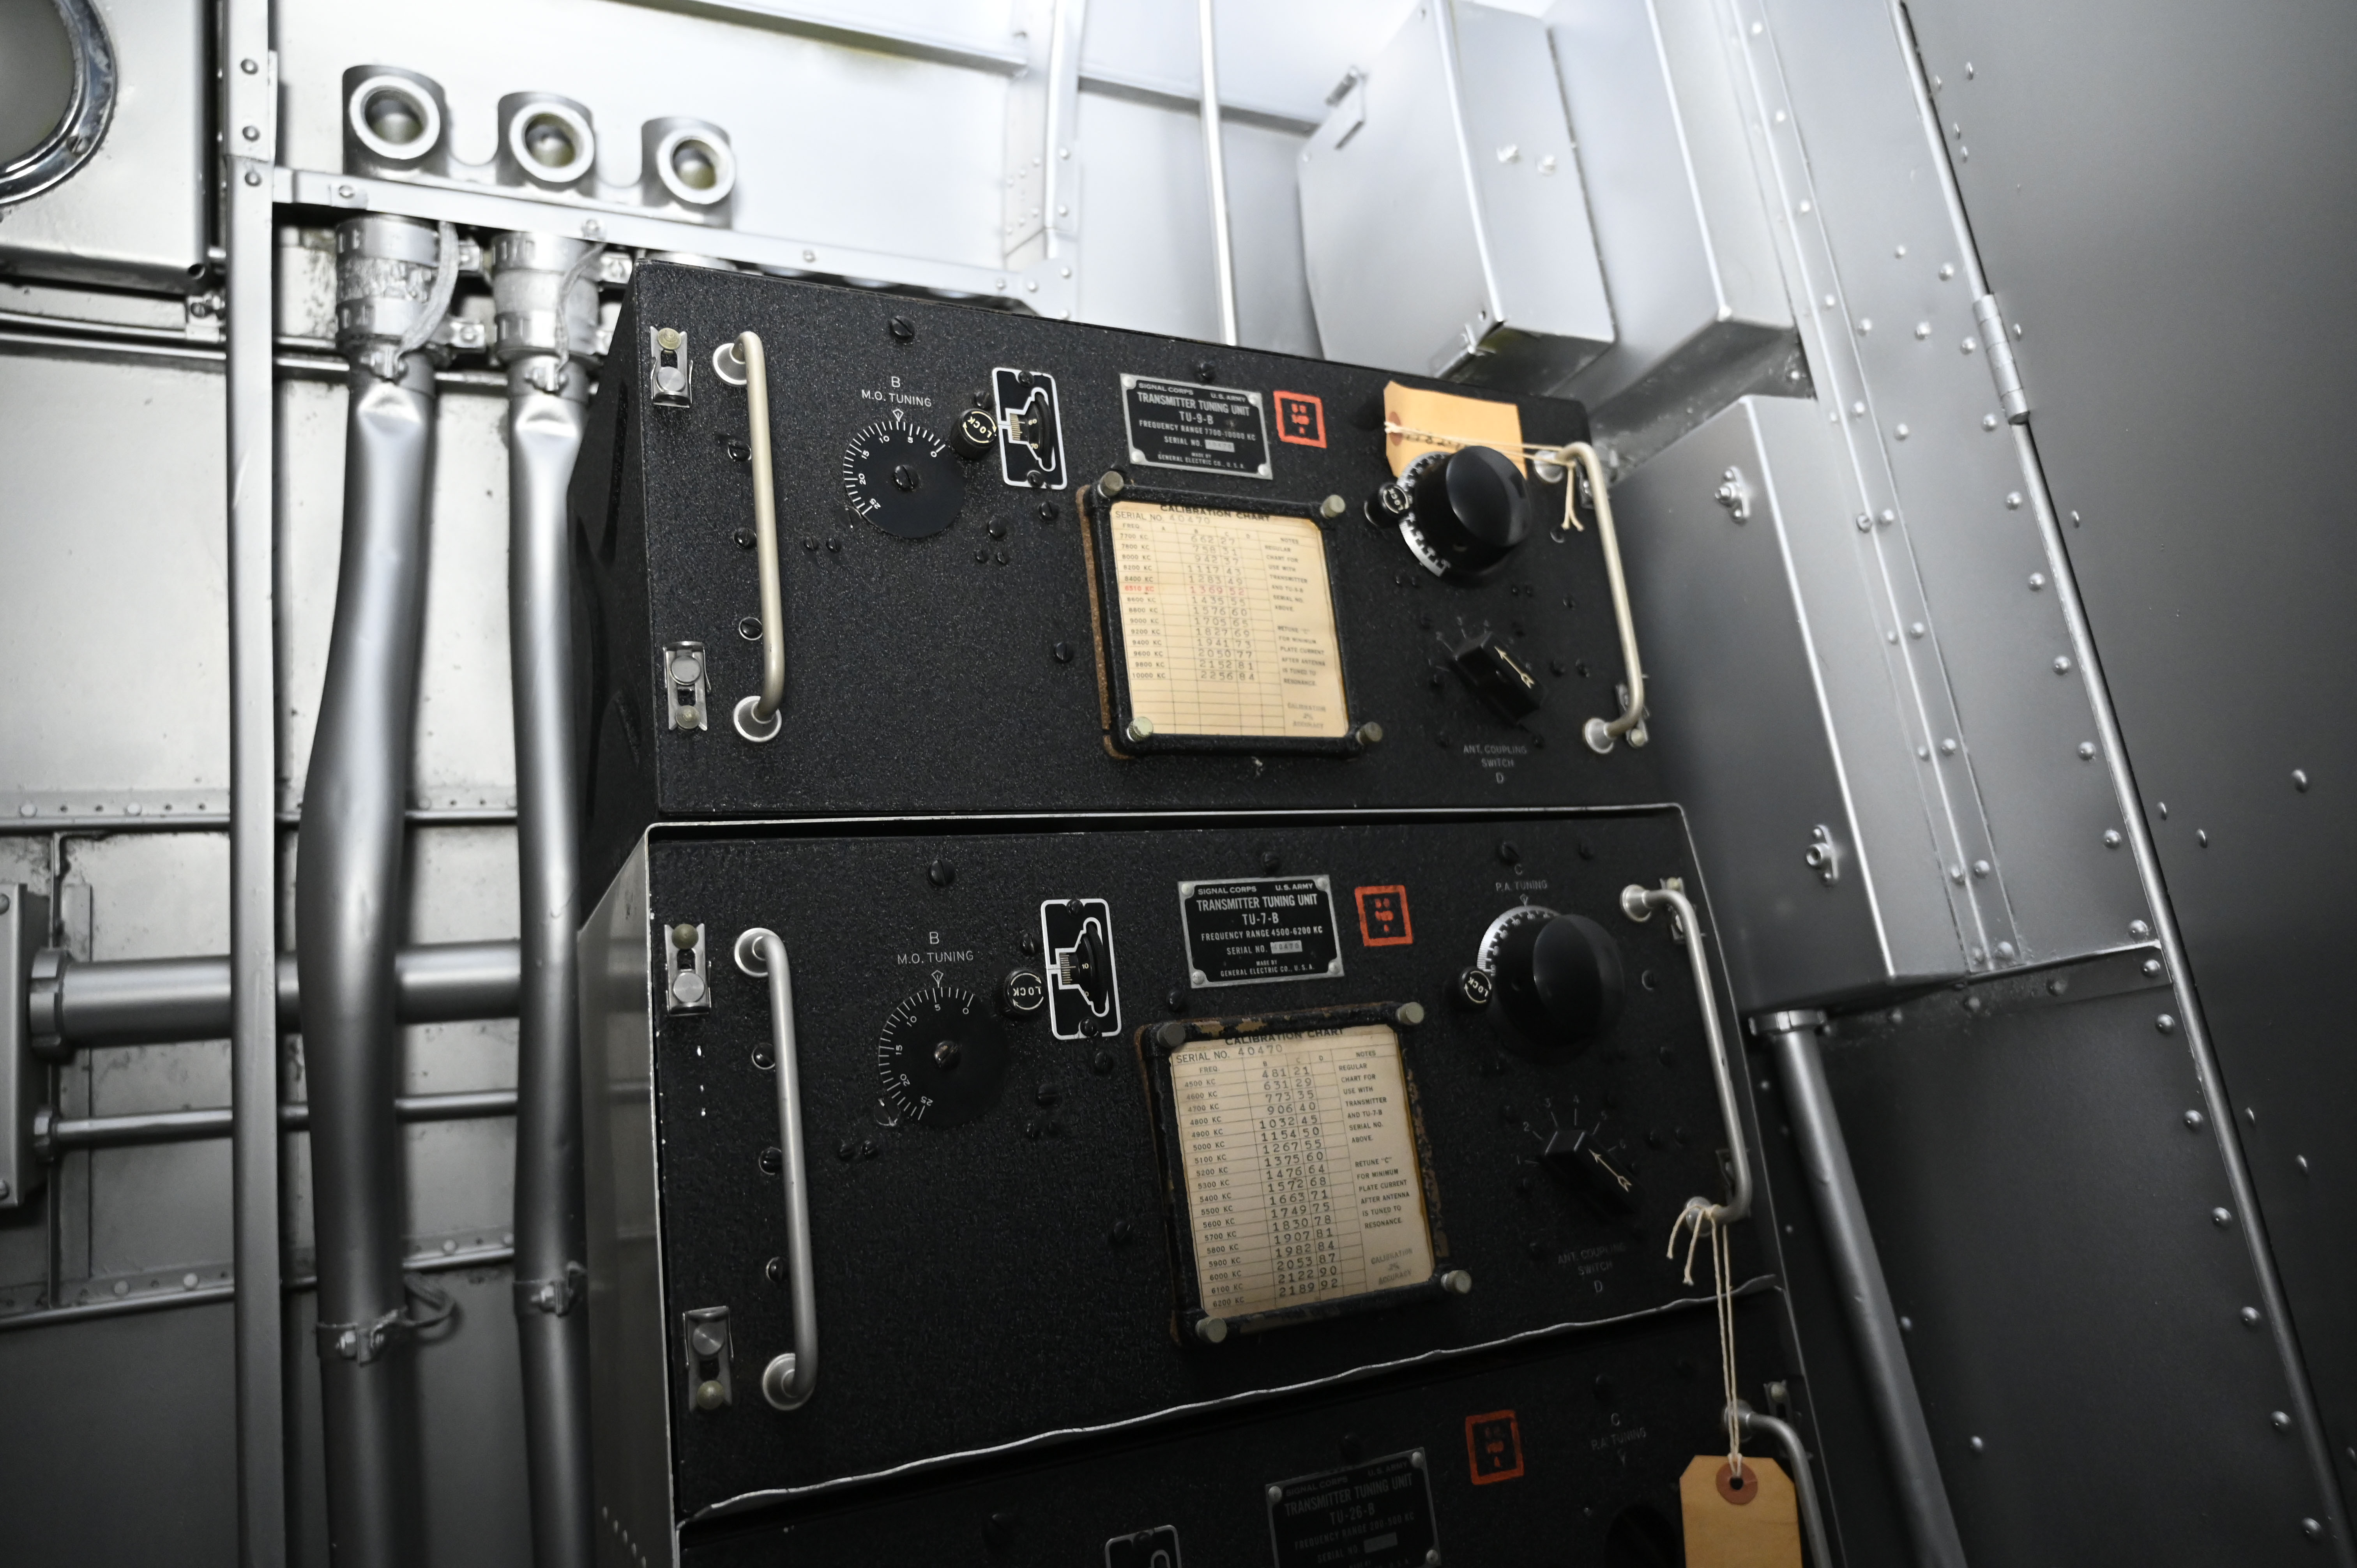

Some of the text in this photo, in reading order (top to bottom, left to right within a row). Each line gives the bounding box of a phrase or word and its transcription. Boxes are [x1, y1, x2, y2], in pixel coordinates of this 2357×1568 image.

[891, 376, 900, 387] B
[1138, 382, 1194, 396] SIGNAL CORPS
[862, 391, 932, 407] M.O. TUNING
[1137, 392, 1250, 416] TRANSMITTER TUNING UNIT
[1226, 394, 1246, 403] ARMY
[1179, 411, 1214, 425] TU-9-B
[967, 416, 992, 438] LOCK
[1139, 420, 1178, 431] FREQUENCY
[1180, 424, 1203, 434] RANGE
[1164, 436, 1187, 445] SERIAL
[861, 450, 870, 459] 15
[1158, 453, 1211, 465] GENERAL ELECTRIC
[859, 473, 866, 485] 20
[869, 498, 881, 509] 25
[1115, 511, 1146, 520] SERIAL
[1160, 505, 1270, 522] CALIBRATION CHART
[1463, 745, 1527, 754] ANT. COUPLING
[1481, 758, 1514, 767] SWITCH
[1495, 772, 1504, 784] D
[1515, 864, 1523, 875] C
[1198, 886, 1228, 895] SIGNAL
[1230, 885, 1257, 893] CORPS
[1514, 879, 1548, 890] TUNING
[1196, 893, 1318, 911] TRANSMITTER TUNING UNIT
[1242, 912, 1279, 925] TU-7-B
[930, 932, 939, 944] B
[1201, 931, 1243, 941] FREQUENCY
[1246, 929, 1270, 938] RANGE
[1271, 927, 1311, 936] 4500-6200
[1227, 946, 1252, 955] SERIAL
[1255, 945, 1267, 953] NO.
[898, 950, 974, 964] M.O. TUNING
[1221, 968, 1247, 977] GENERAL
[1249, 967, 1278, 975] ELECTRIC
[1013, 986, 1041, 996] LOCK
[1468, 977, 1489, 997] LOCK
[906, 1015, 917, 1027] 10
[1225, 1029, 1344, 1045] CALIBRATION CHART
[896, 1045, 903, 1054] 15
[1176, 1053, 1210, 1063] SERIAL
[1238, 1044, 1282, 1055] 40470
[900, 1074, 910, 1086] 20
[921, 1096, 933, 1105] 25
[1345, 1097, 1387, 1107] TRANSMITTER
[1523, 1122, 1530, 1131] 2
[1264, 1142, 1298, 1154] 1267
[1306, 1139, 1322, 1149] 55
[1267, 1167, 1302, 1180] 1476
[1309, 1164, 1325, 1173] 64
[1372, 1169, 1398, 1177] MINIMUM
[1380, 1179, 1407, 1188] CURRENT
[1270, 1192, 1305, 1205] 1663
[1311, 1190, 1328, 1199] 71
[1360, 1192, 1410, 1204] AFTER ANTENNA
[1277, 1257, 1313, 1270] 2053
[1319, 1253, 1335, 1264] 87
[1371, 1248, 1413, 1265] CALIBRATION
[1578, 1261, 1613, 1275] SWITCH
[1378, 1270, 1412, 1285] ACCURACY
[1594, 1280, 1603, 1293] D
[1611, 1413, 1620, 1426] C
[1610, 1427, 1646, 1445] TUNING
[1386, 1461, 1407, 1473] ARMY
[1286, 1476, 1348, 1496] SIGNAL CORPS
[1285, 1473, 1413, 1517] TRANSMITTER TUNING UNIT
[1330, 1503, 1375, 1525] TU-26-B
[1295, 1531, 1339, 1550] FREQUENCY
[1342, 1524, 1367, 1538] RANGE
[1405, 1511, 1415, 1522] KC
[1317, 1549, 1344, 1563] SERIAL
